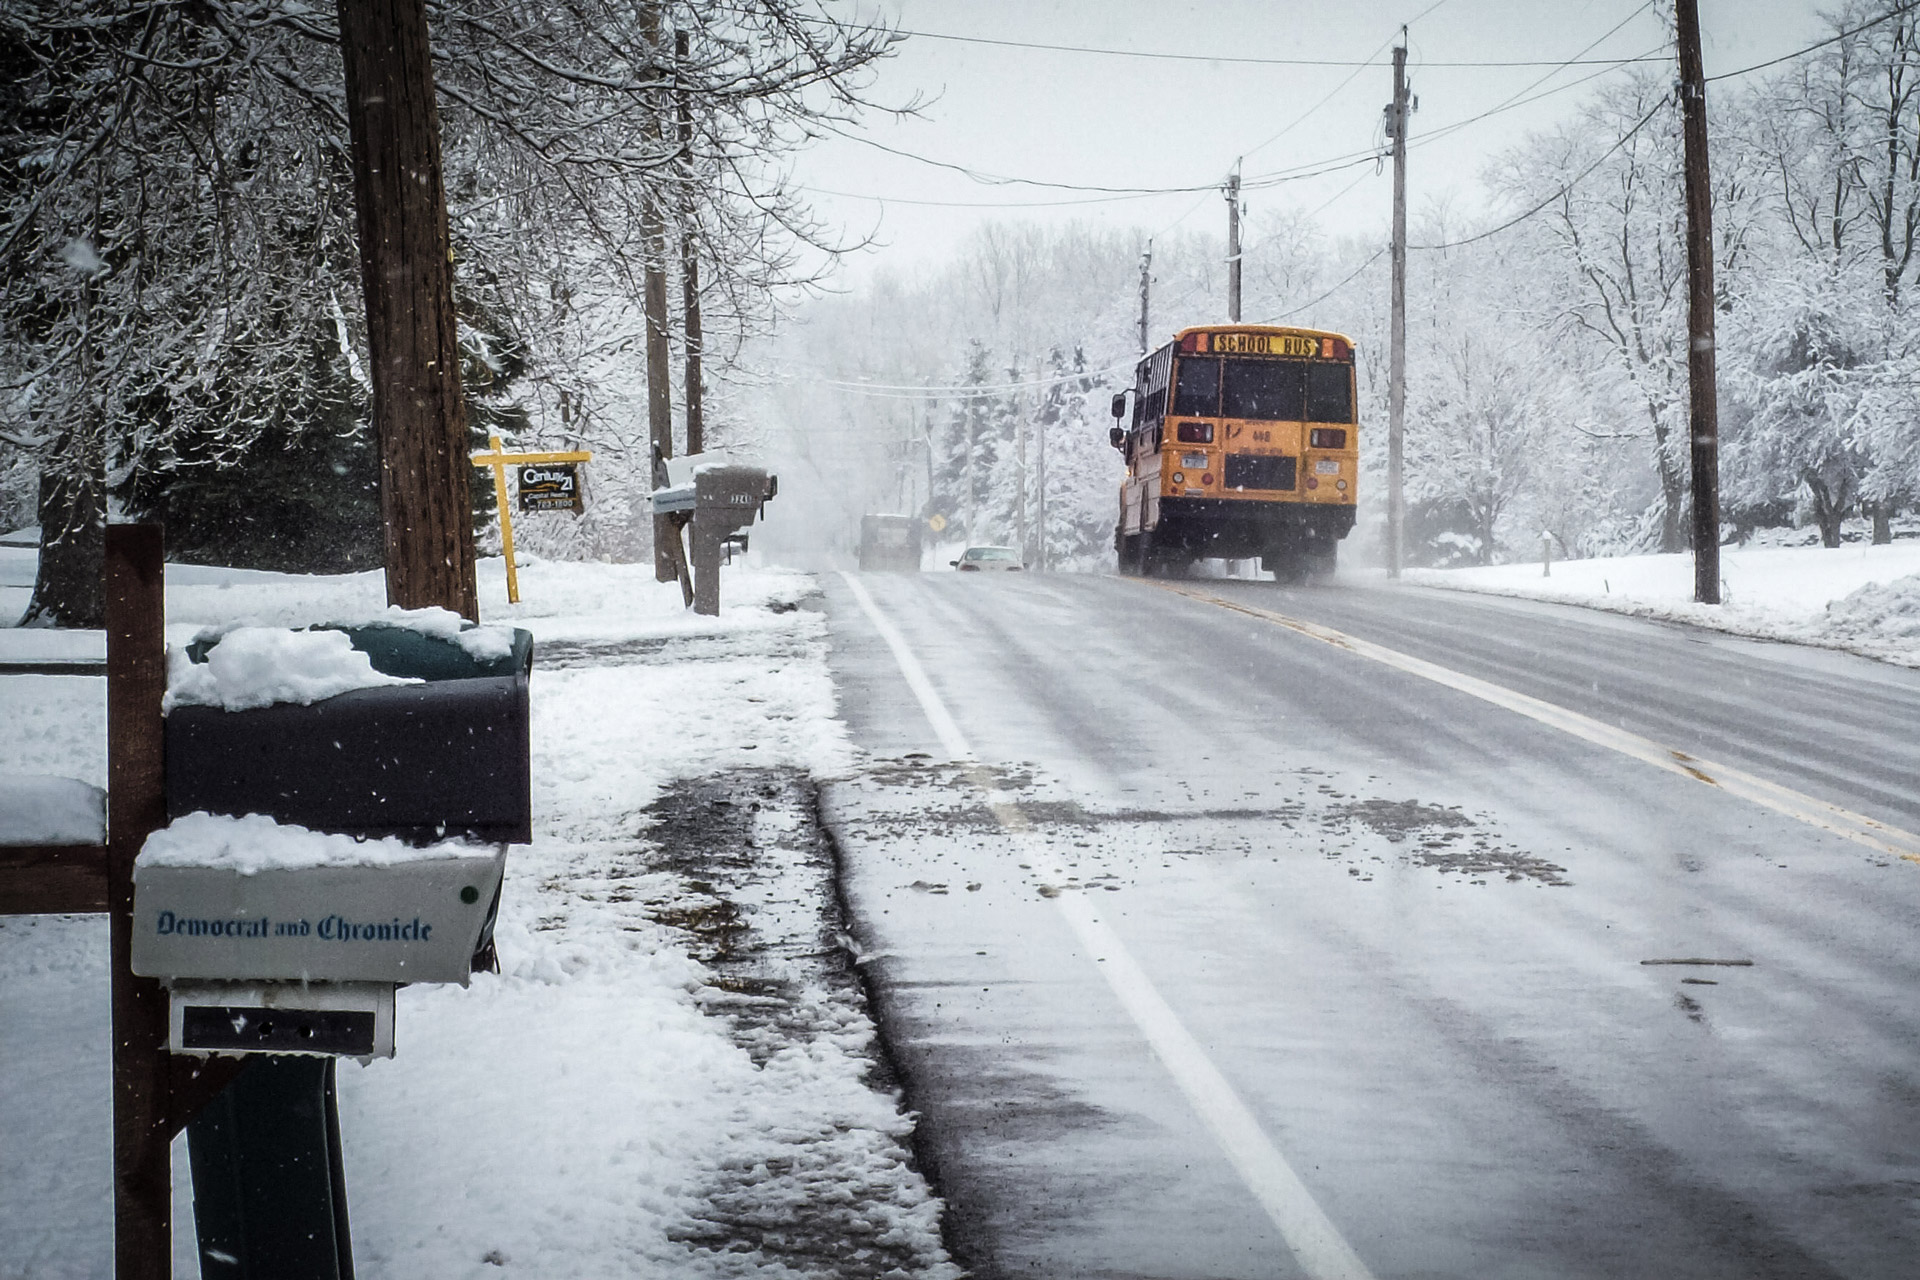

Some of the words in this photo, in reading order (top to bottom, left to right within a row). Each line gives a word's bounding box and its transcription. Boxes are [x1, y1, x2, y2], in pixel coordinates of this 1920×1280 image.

[1219, 334, 1273, 353] SCHOOL
[1284, 337, 1312, 355] BUS
[523, 468, 565, 484] Century
[560, 475, 573, 491] 21
[157, 910, 269, 938] Democrat
[275, 917, 310, 937] and
[317, 913, 433, 942] Chronicle
